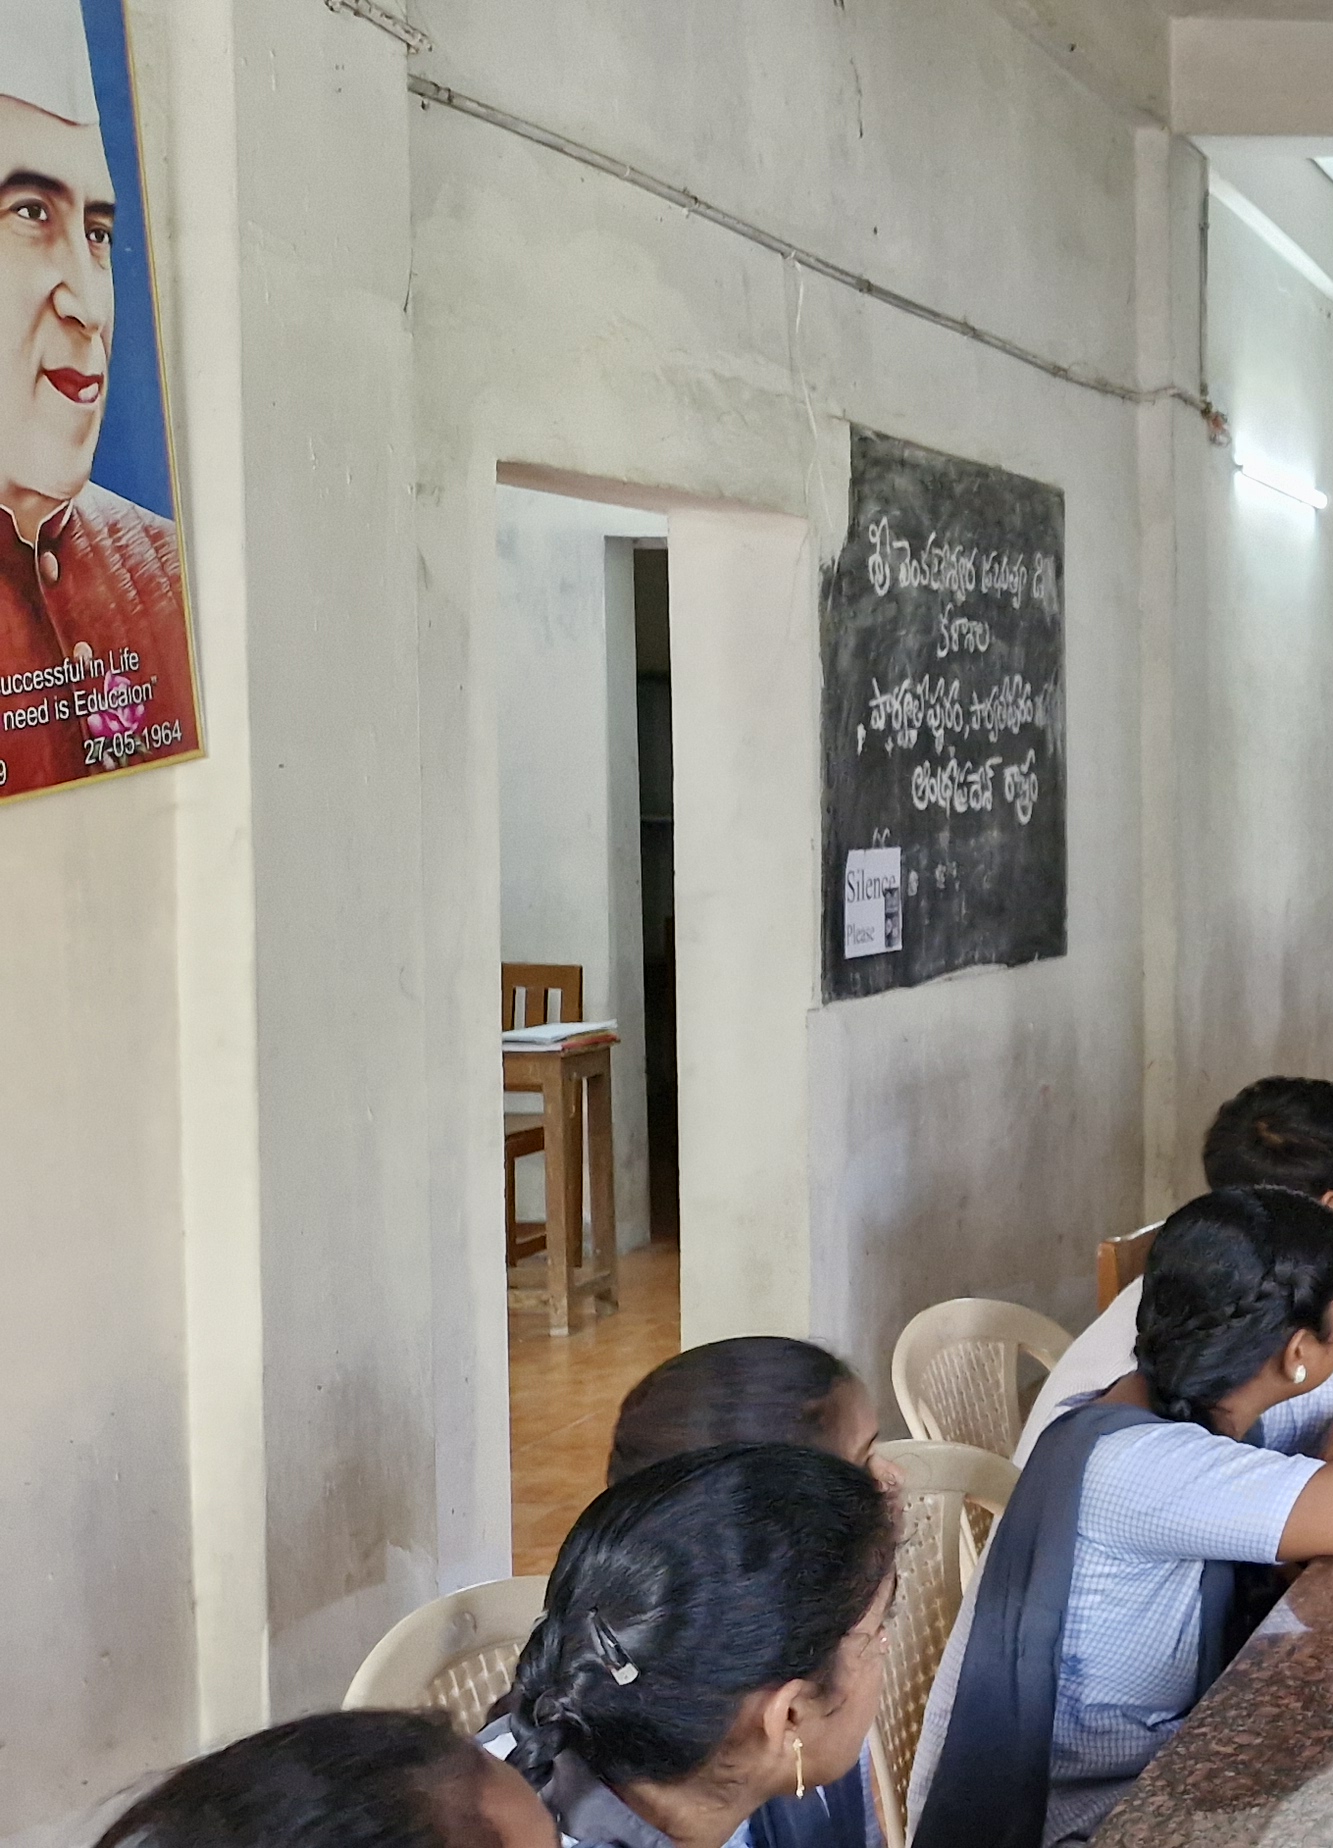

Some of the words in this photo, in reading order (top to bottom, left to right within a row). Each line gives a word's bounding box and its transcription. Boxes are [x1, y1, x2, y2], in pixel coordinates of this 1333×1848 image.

[867, 516, 891, 597] శ్రీ
[936, 602, 990, 659] కళాశాల
[0, 657, 86, 697] uccessful
[89, 656, 105, 679] in
[109, 647, 139, 675] Life
[3, 698, 49, 732] need
[54, 695, 70, 721] is
[83, 719, 182, 766] 27-05-1964
[846, 869, 896, 903] Silence
[846, 924, 875, 946] Please
